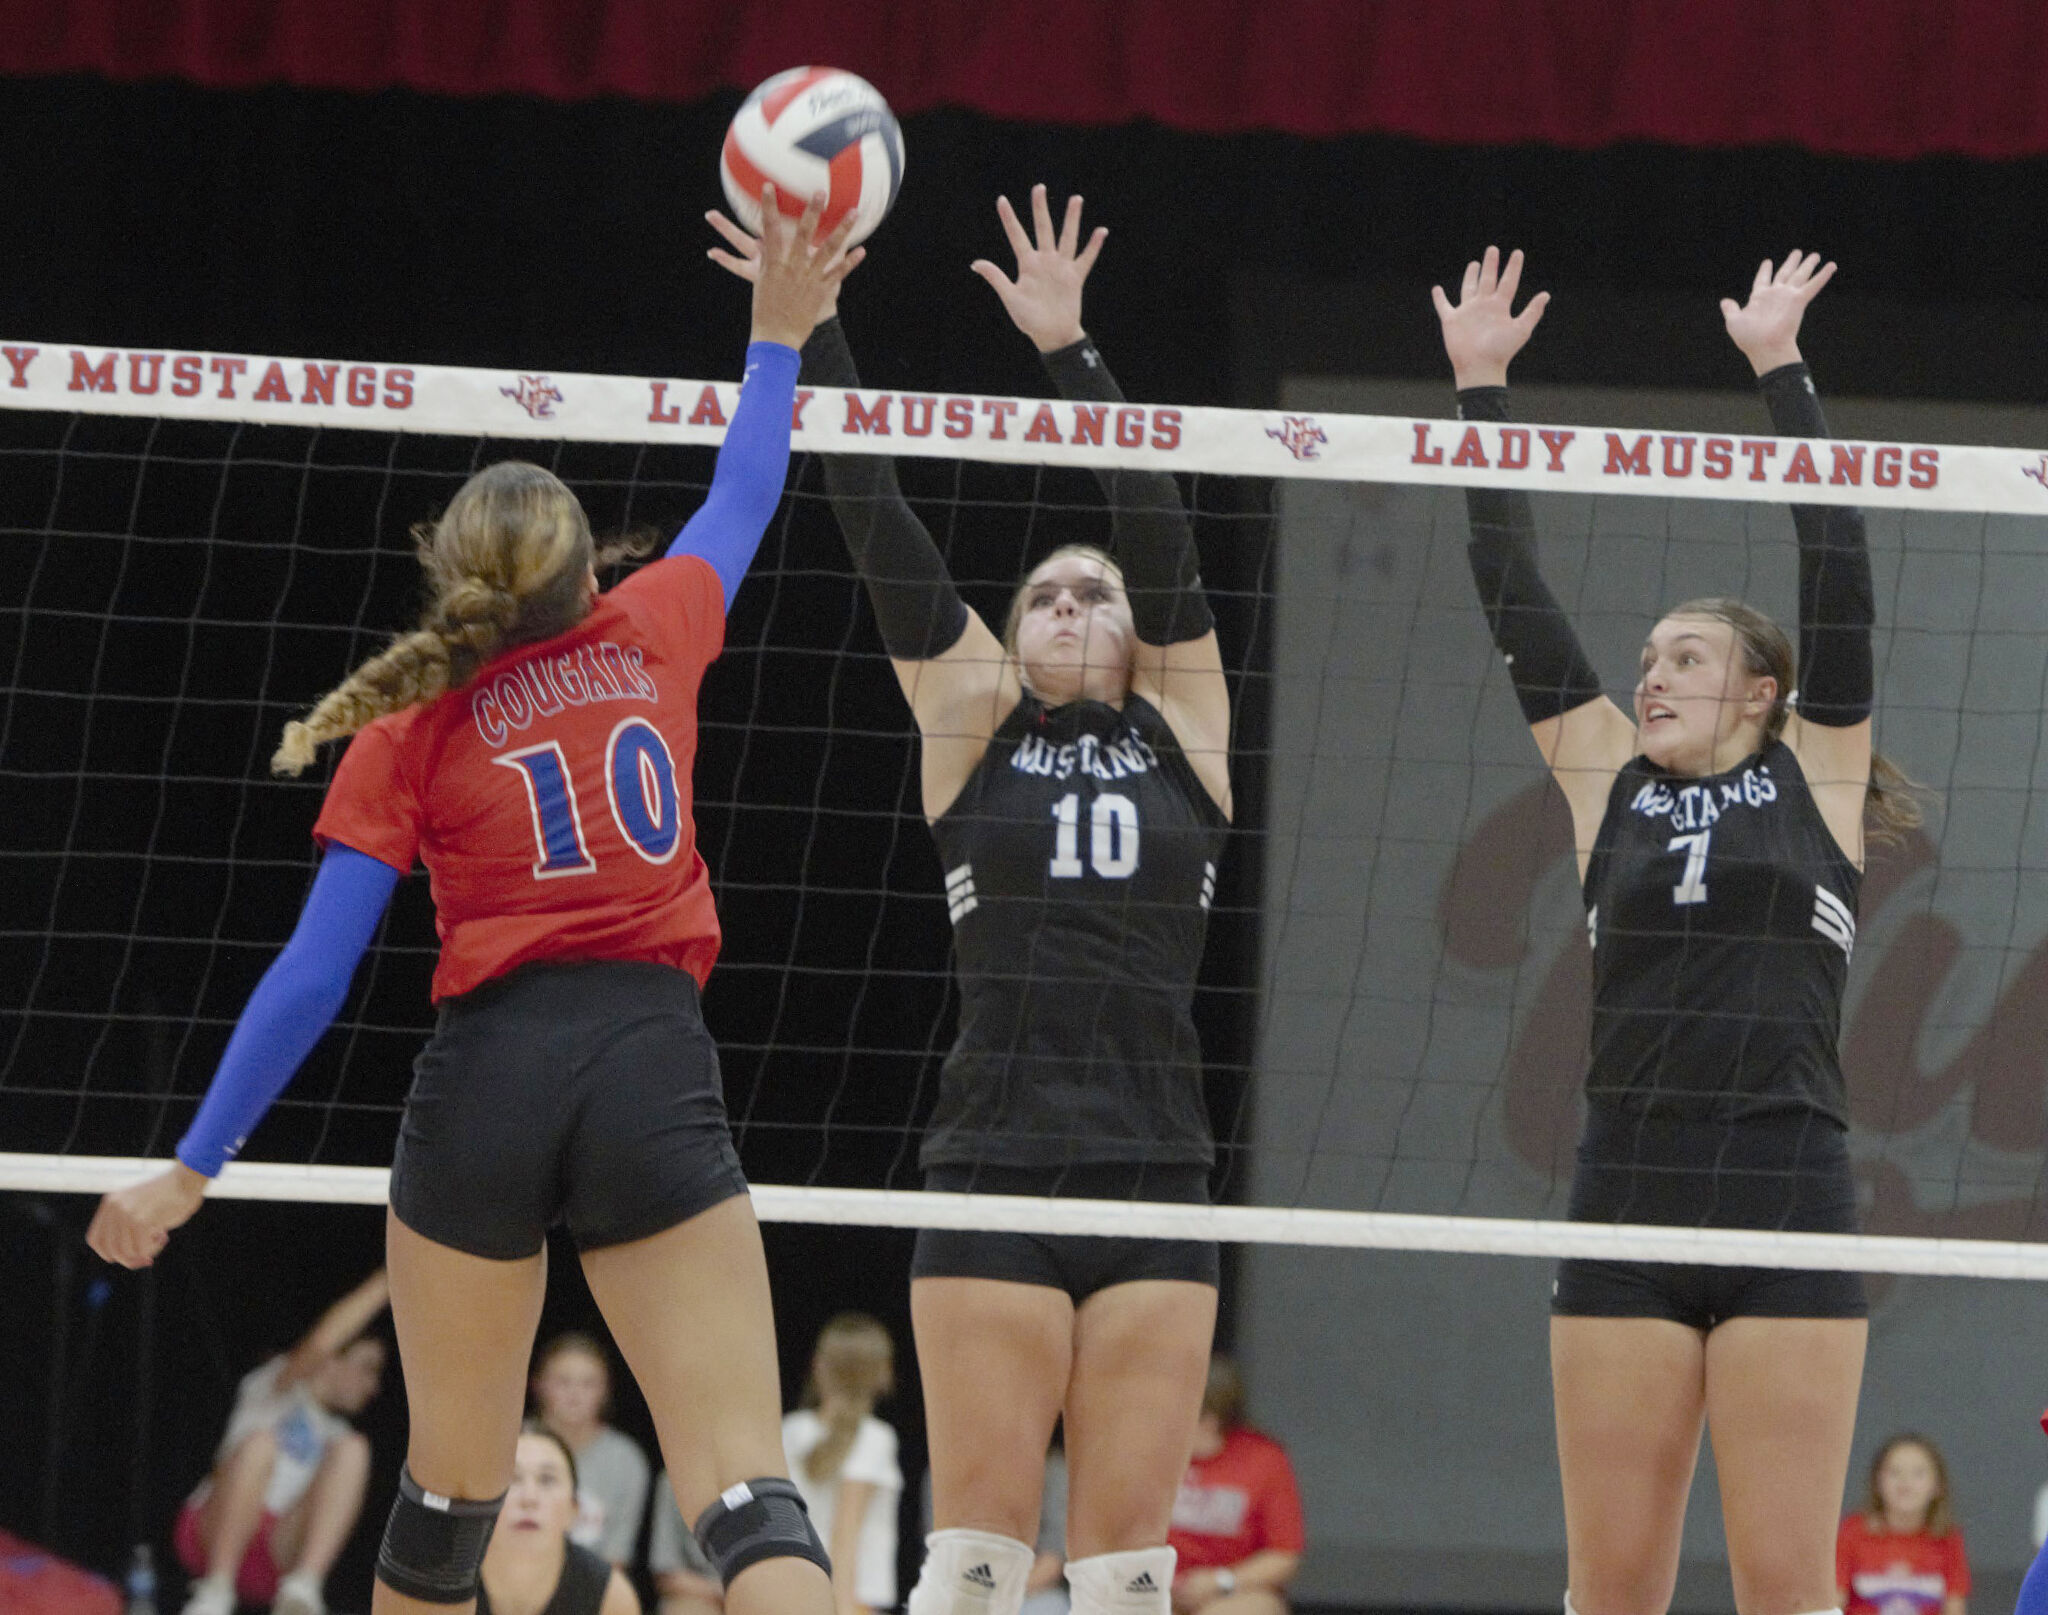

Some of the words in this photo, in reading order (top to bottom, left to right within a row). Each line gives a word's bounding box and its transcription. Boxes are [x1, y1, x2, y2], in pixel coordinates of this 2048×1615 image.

[1, 346, 39, 389] Y
[67, 350, 415, 411] MUSTANGS
[647, 382, 815, 432] LAY
[842, 392, 1182, 451] MUSTANGS
[1410, 423, 1576, 473] LADY
[1603, 433, 1940, 490] MUSTANGS
[471, 641, 659, 749] COUGARS
[491, 715, 683, 880] 10
[1050, 792, 1140, 879] 10
[1667, 828, 1711, 905] 7
